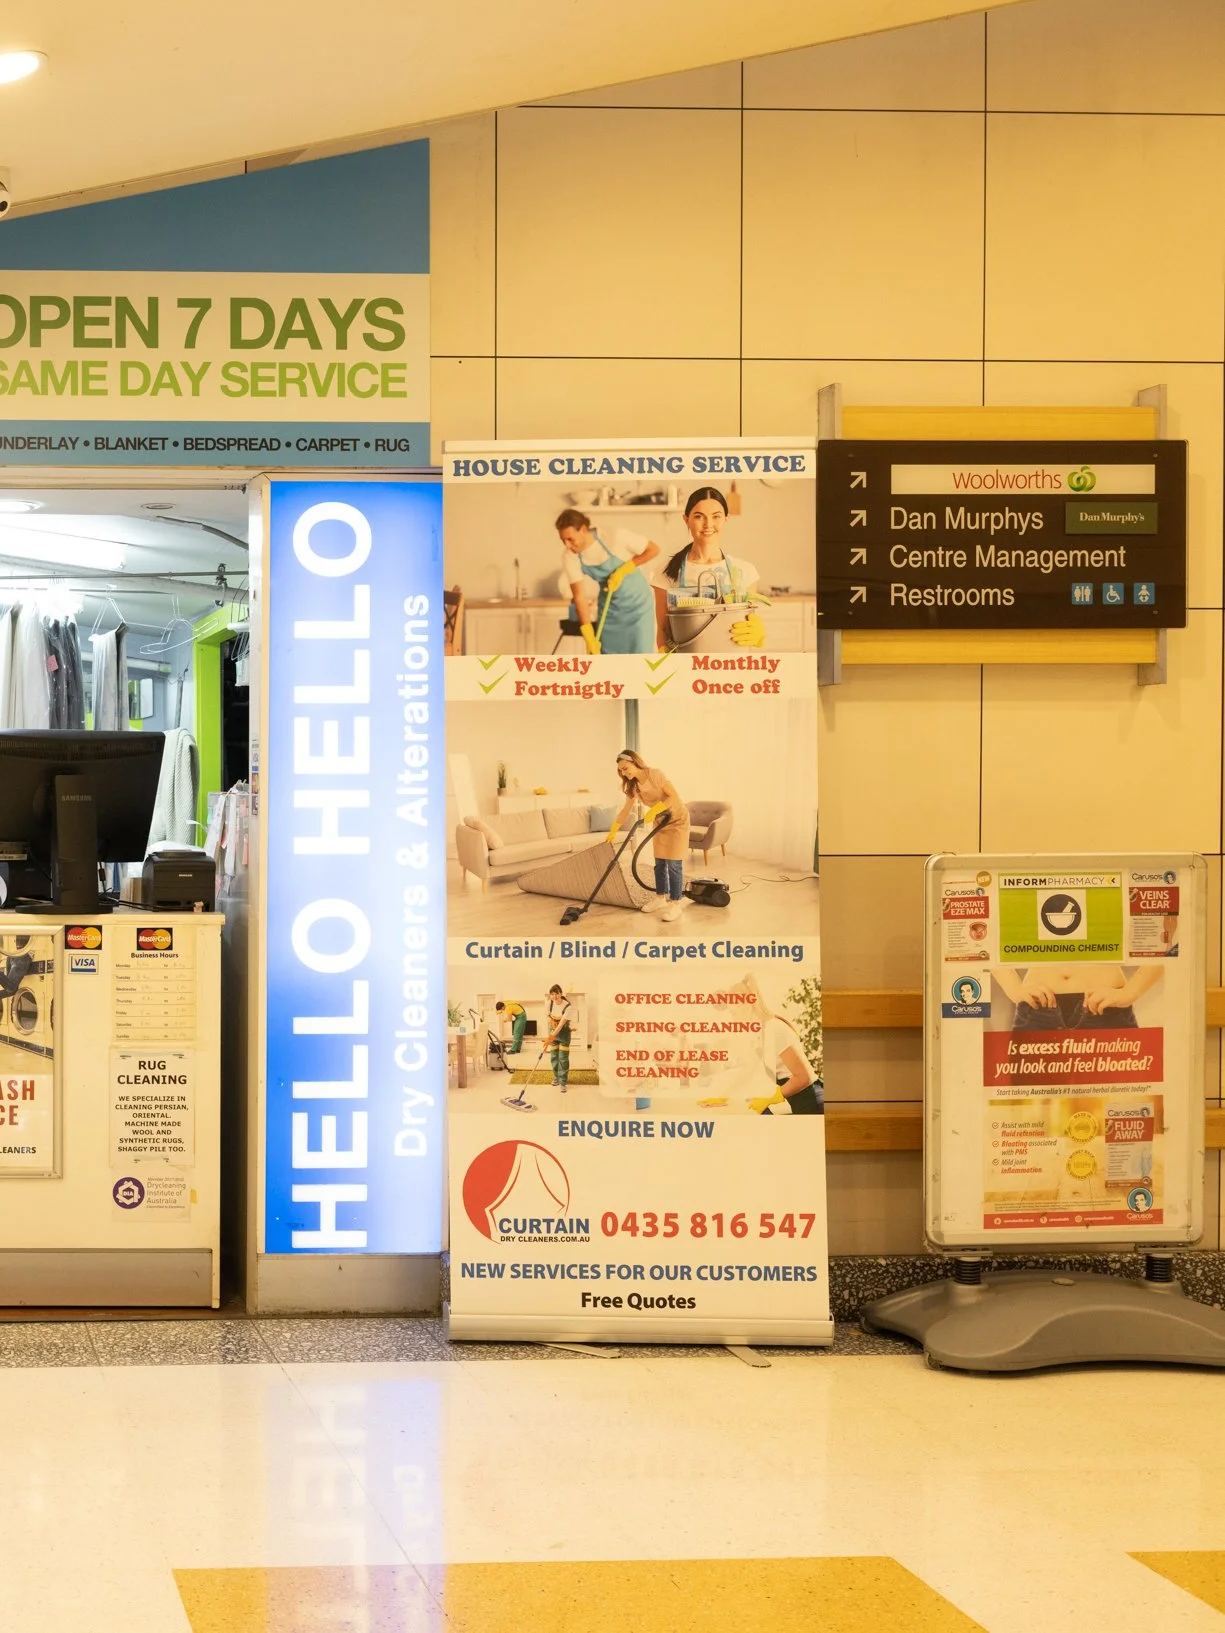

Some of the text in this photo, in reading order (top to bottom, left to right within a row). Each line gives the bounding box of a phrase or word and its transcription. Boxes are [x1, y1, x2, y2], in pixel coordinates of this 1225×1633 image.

[176, 297, 213, 349] 7
[230, 296, 407, 352] DAYS
[120, 360, 212, 397] DAY
[220, 360, 408, 399] SERVICE
[94, 436, 169, 452] BLANKET
[183, 436, 281, 452] BEDSPREAD
[295, 437, 361, 453] CARPET
[375, 437, 410, 453] RUG
[452, 455, 806, 477] HOUSE CLEANING SERVICE
[952, 468, 1062, 489] Woolworths
[889, 506, 1044, 536] Dan Murphys
[1079, 511, 1145, 524] Dan Murphy's
[889, 544, 1126, 573] Centre Management
[889, 582, 1015, 607] Restrooms
[514, 655, 781, 675] Weekly Monthly
[514, 678, 781, 699] Fortnigtly Once off
[291, 501, 373, 1249] HELLO HELLO
[394, 593, 436, 1158] Dry Cleaners & Alterations
[1139, 890, 1169, 900] VEINS
[950, 900, 985, 908] PROSTATE
[950, 907, 985, 916] EZE MAX
[1139, 900, 1170, 909] CLEAR
[67, 934, 102, 942] MasterCard
[138, 935, 172, 943] MasterCard
[465, 940, 804, 963] Curtain / Blind / Carpet Cleaning
[1003, 943, 1119, 953] COMPOUNDING CHEMIST
[74, 958, 96, 967] VISA
[614, 992, 757, 1005] OFFICE CLEANING
[615, 1021, 761, 1033] SPRING CLEANING
[1007, 1037, 1141, 1055] Is excess fluid making
[615, 1049, 728, 1062] END OF LEASE
[138, 1060, 167, 1070] RUG
[615, 1066, 700, 1079] CLEANING
[995, 1055, 1154, 1079] you look and feel bloated?
[117, 1074, 187, 1085] CLEANING
[558, 1120, 715, 1140] ENQUIRE NOW
[1114, 1120, 1145, 1131] FLUID
[1114, 1130, 1144, 1140] AWAY
[498, 1217, 590, 1235] CURTAIN
[600, 1210, 817, 1239] 0435 816 547
[517, 1235, 590, 1243] CLEANERS.COM.AU
[461, 1262, 817, 1282] NEW SERVICES FOR OUR CUSTOMERS
[581, 1292, 696, 1311] Free Quotes
